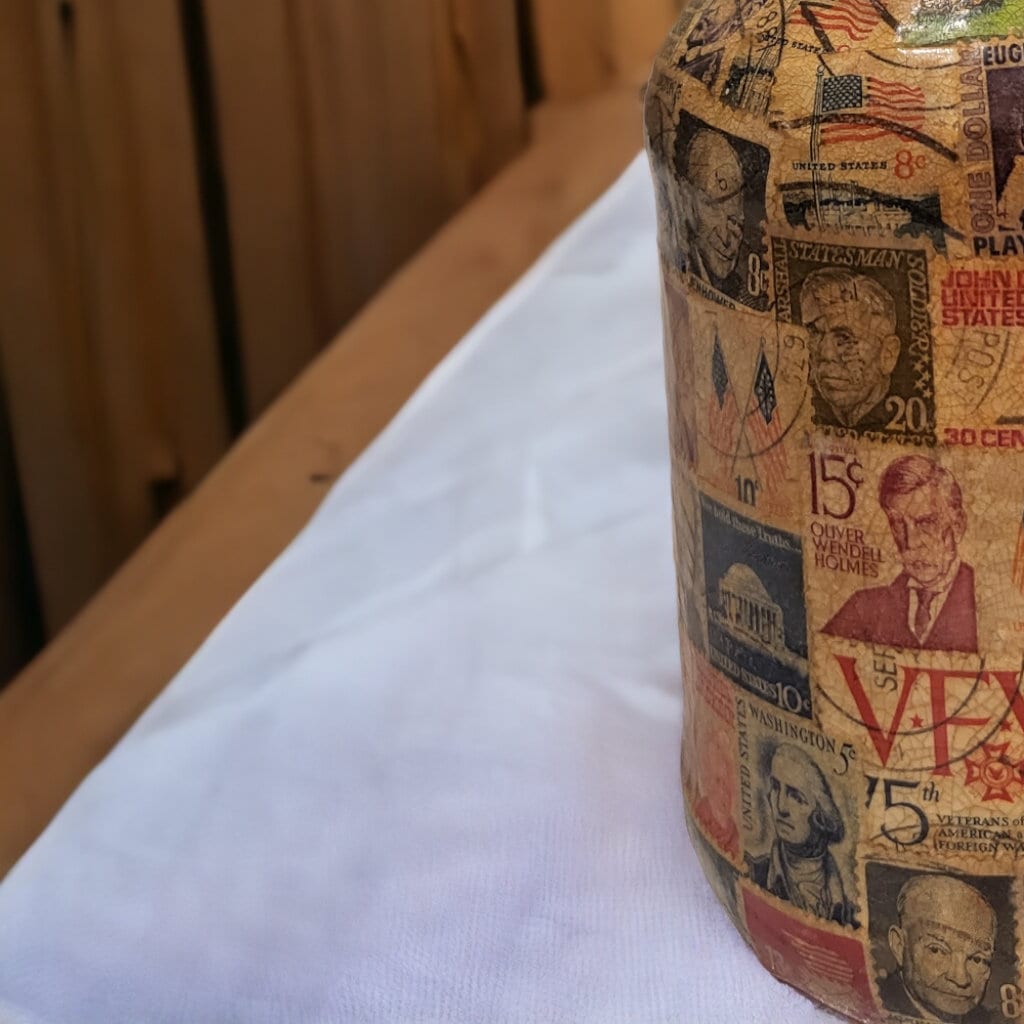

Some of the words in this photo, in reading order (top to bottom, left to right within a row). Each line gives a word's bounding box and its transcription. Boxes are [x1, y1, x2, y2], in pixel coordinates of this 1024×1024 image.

[792, 163, 836, 172] UNITED
[840, 162, 888, 172] STATES
[966, 170, 996, 235] ONE
[789, 240, 904, 269] STATESMAN
[773, 239, 792, 324] ARSHALL
[941, 268, 1012, 289] JOHN
[907, 254, 930, 358] SOLDIER
[943, 427, 977, 447] 30
[810, 522, 864, 544] OLIVER
[812, 537, 885, 563] WENDELL
[815, 554, 880, 578] HOLMES
[736, 695, 749, 761] STATES
[750, 702, 837, 754] WASHINGTON
[740, 765, 754, 832] UNITED
[936, 813, 1010, 827] VETERANS
[937, 827, 1011, 840] AMERICAN
[938, 840, 998, 853] FOREIGN
